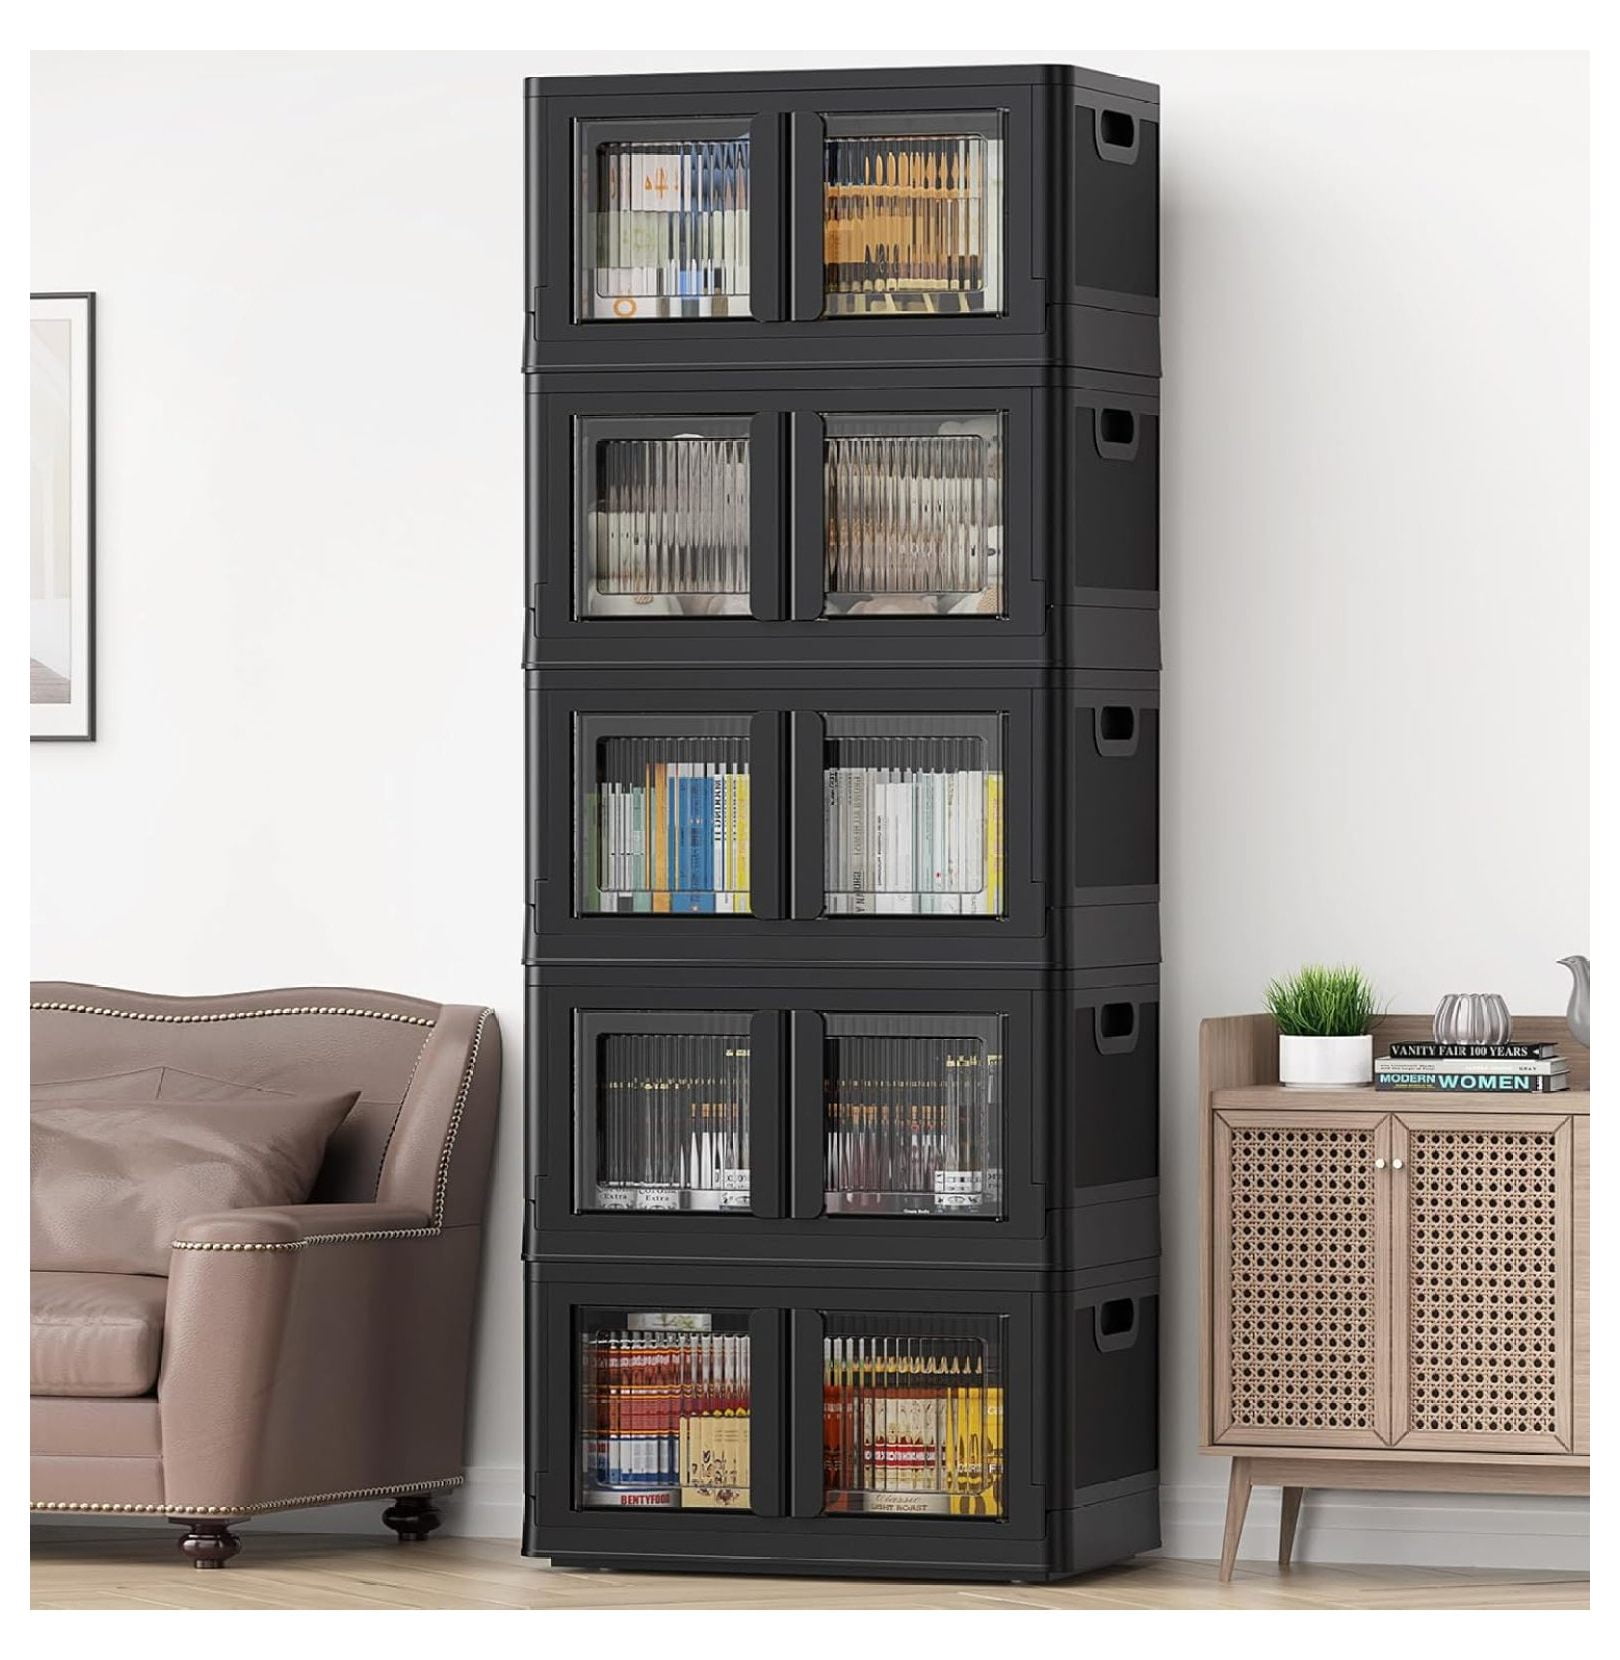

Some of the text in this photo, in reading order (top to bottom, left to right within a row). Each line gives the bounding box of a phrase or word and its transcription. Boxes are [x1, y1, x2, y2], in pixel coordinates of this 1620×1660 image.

[1391, 1045, 1528, 1057] VANITY FAIR 100 YEARS
[1380, 1074, 1436, 1083] MODERN
[1438, 1075, 1530, 1090] WOMEN
